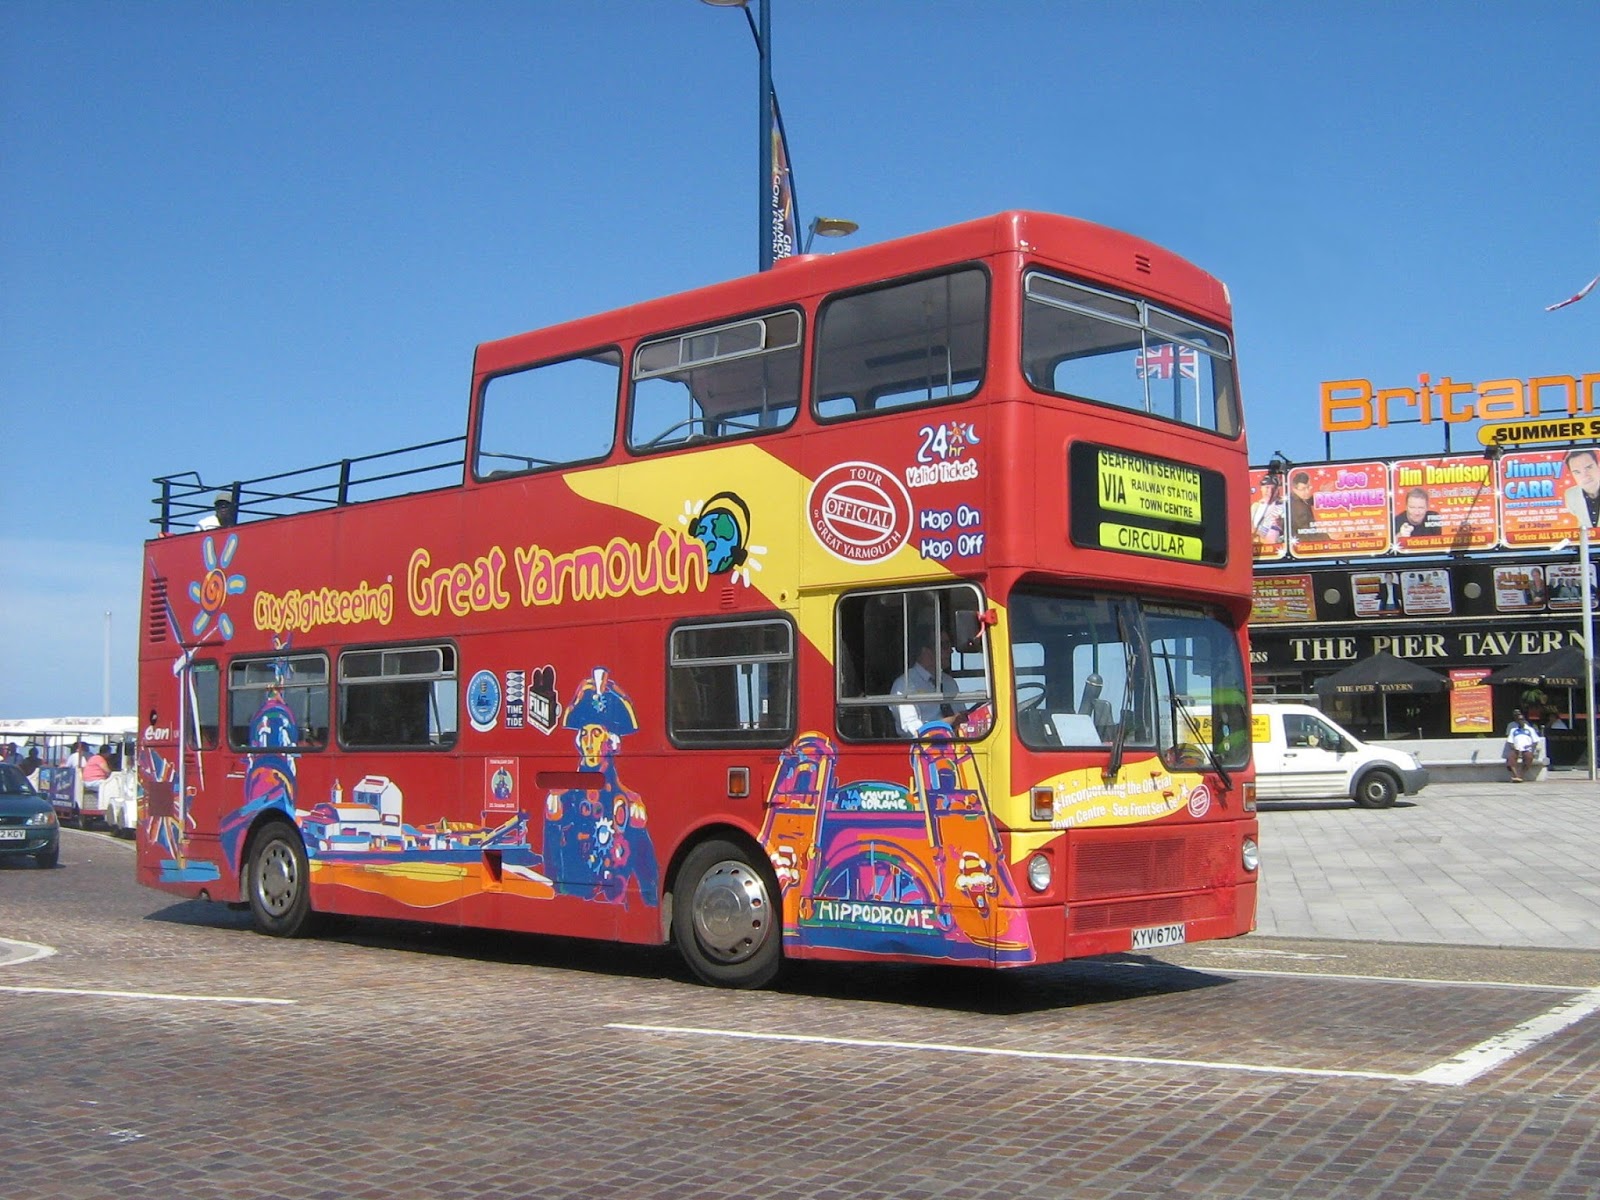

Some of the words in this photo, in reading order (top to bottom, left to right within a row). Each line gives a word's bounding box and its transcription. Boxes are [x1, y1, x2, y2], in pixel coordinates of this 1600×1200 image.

[1495, 422, 1584, 442] SUMMER
[850, 468, 882, 486] TOUR
[906, 465, 937, 487] Valid
[938, 458, 978, 482] Ticket
[1101, 450, 1156, 476] SEAFRONT
[1157, 462, 1198, 485] SERVICE
[1336, 470, 1368, 488] Joe
[1400, 466, 1422, 486] Jim
[1426, 464, 1490, 486] Davidson
[1504, 460, 1563, 478] Jimmy
[1102, 472, 1126, 504] VIA
[1132, 479, 1166, 496] RAILWAY
[1168, 486, 1198, 502] STATION
[1447, 497, 1474, 505] LIVE
[1504, 480, 1554, 500] CARR
[826, 498, 890, 528] OFFICIAL
[921, 510, 952, 531] Hop
[957, 505, 980, 527] On
[1140, 498, 1162, 512] TOWN
[1164, 502, 1193, 518] CENTRE
[816, 520, 842, 550] GREAT
[843, 530, 902, 558] YARMOUTH
[921, 538, 952, 560] Hop
[957, 533, 984, 556] Off
[1118, 528, 1185, 555] CIRCULAR
[408, 546, 510, 616] Great
[514, 524, 708, 607] Yarmouth
[1290, 637, 1357, 662] THE
[1372, 634, 1448, 658] PIER
[1458, 630, 1584, 658] TAVERN
[506, 705, 523, 714] TIME
[530, 696, 550, 721] FILM
[506, 718, 523, 726] TIDE
[1061, 783, 1127, 808] Incorporating
[1127, 780, 1141, 794] the
[1143, 776, 1172, 793] Official
[1050, 816, 1075, 832] Town
[1076, 805, 1106, 823] Centre
[1112, 803, 1129, 816] Sea
[1130, 802, 1152, 816] Front
[819, 902, 934, 929] HIPPODROME
[1132, 928, 1154, 946] KYV
[1156, 926, 1185, 944] 670X
